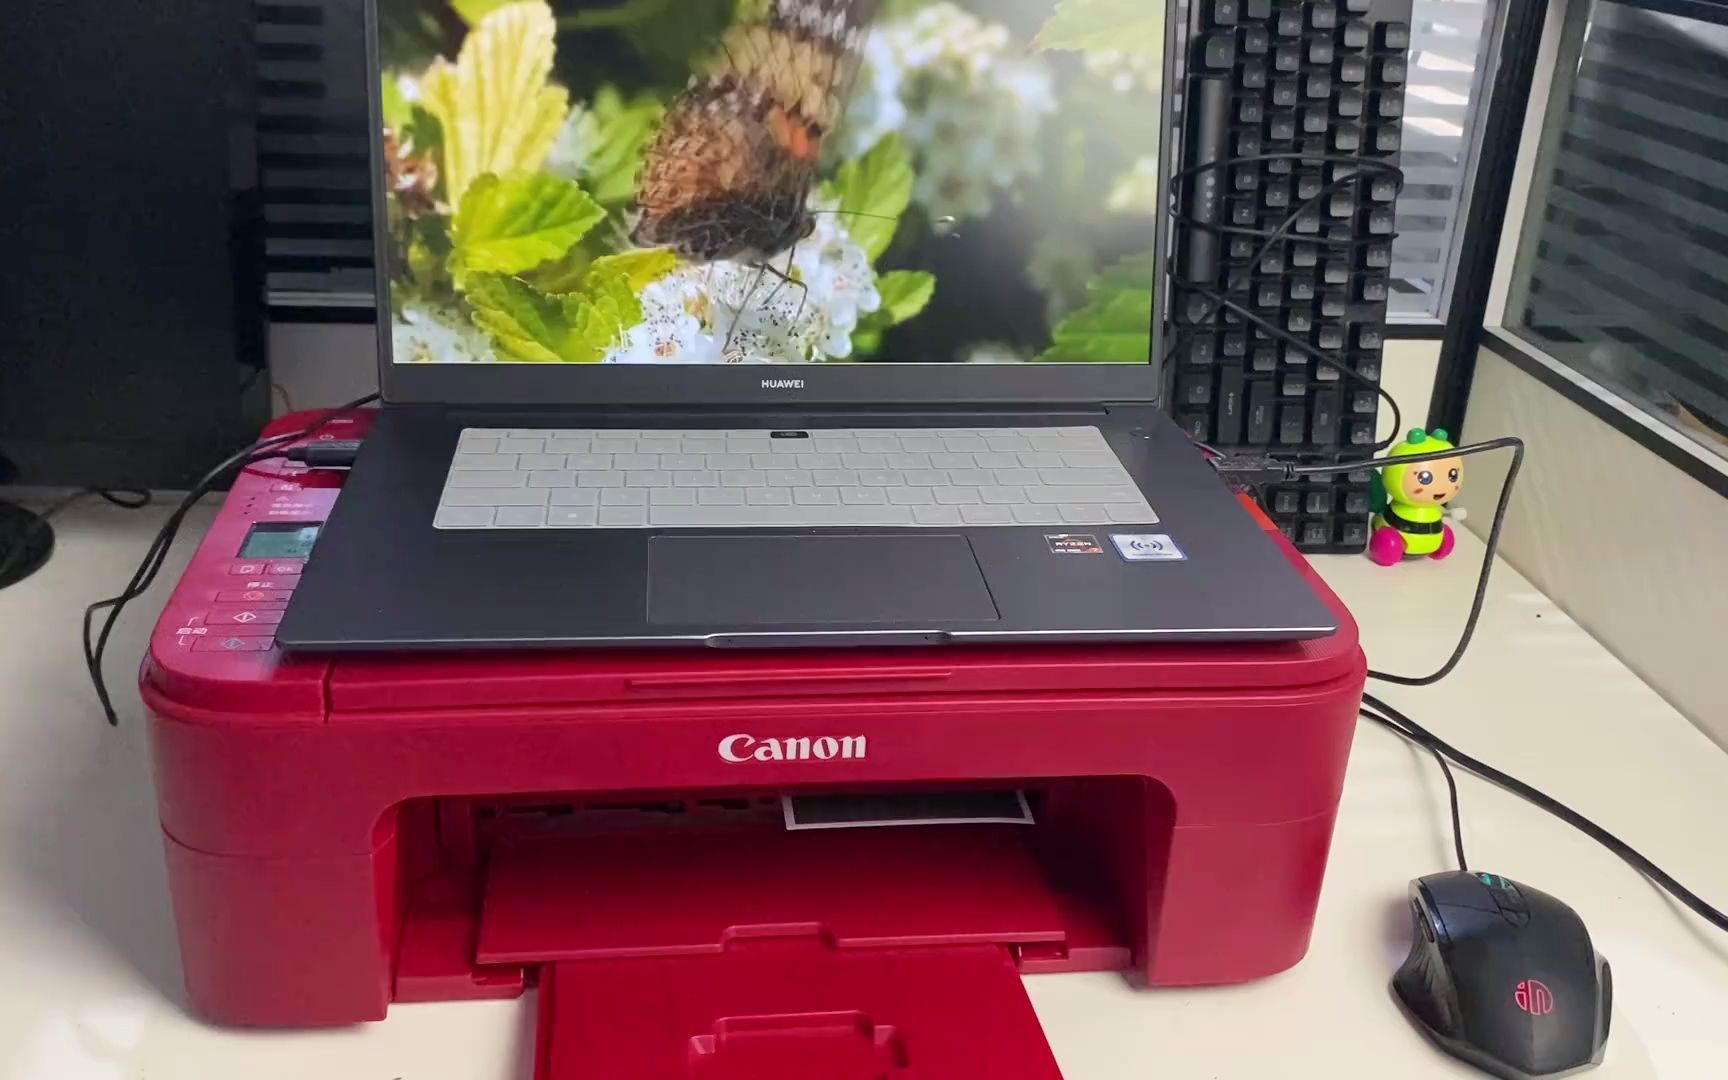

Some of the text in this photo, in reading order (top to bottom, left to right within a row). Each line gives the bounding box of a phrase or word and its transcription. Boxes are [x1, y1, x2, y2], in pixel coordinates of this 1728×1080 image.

[761, 380, 804, 389] HUAWEI
[176, 627, 208, 635] 启动
[718, 733, 867, 763] Canon
